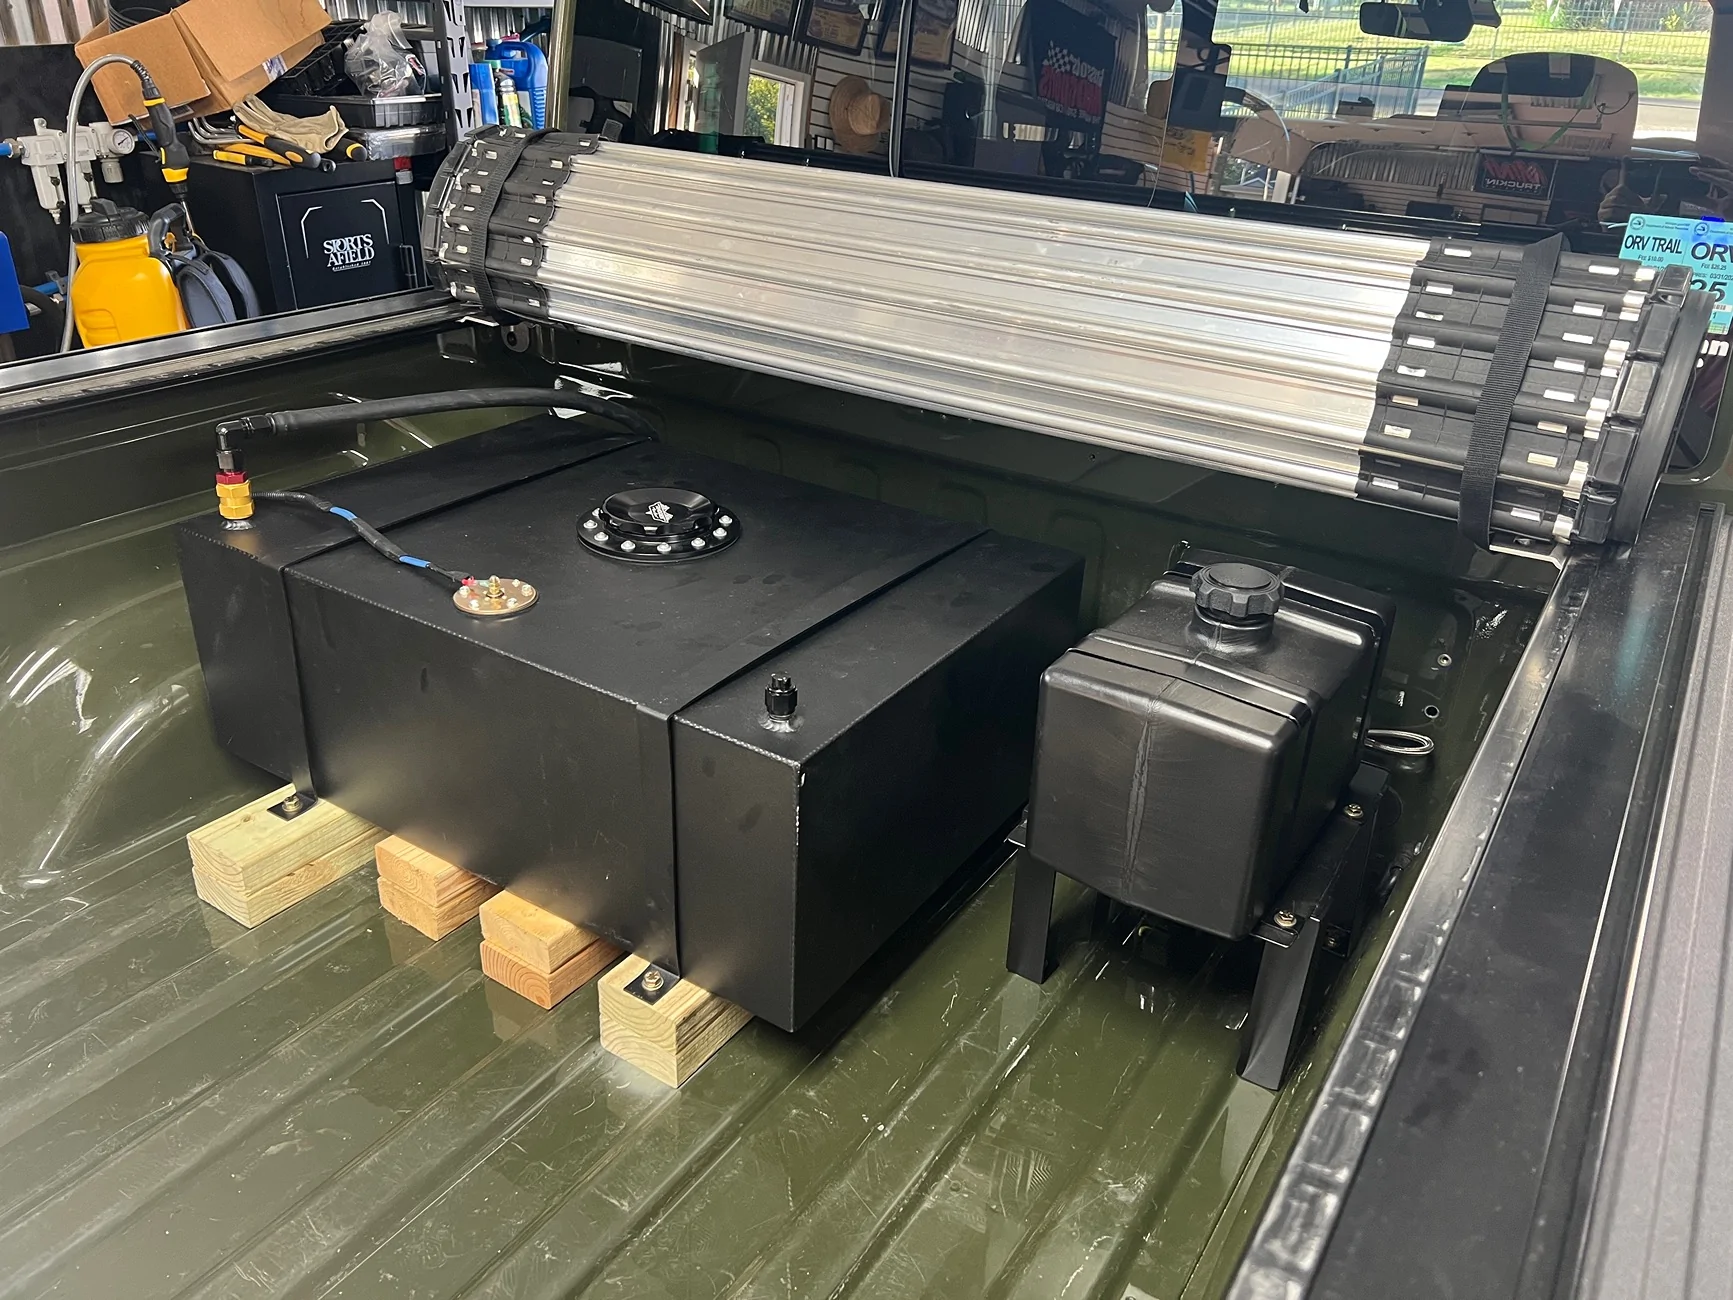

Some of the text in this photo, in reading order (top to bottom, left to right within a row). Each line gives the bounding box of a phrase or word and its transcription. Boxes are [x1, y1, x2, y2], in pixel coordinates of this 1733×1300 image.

[323, 233, 374, 255] SPORTS
[1624, 234, 1683, 254] ORV TRAIL
[1691, 241, 1733, 263] OR
[327, 245, 375, 267] AFIELD
